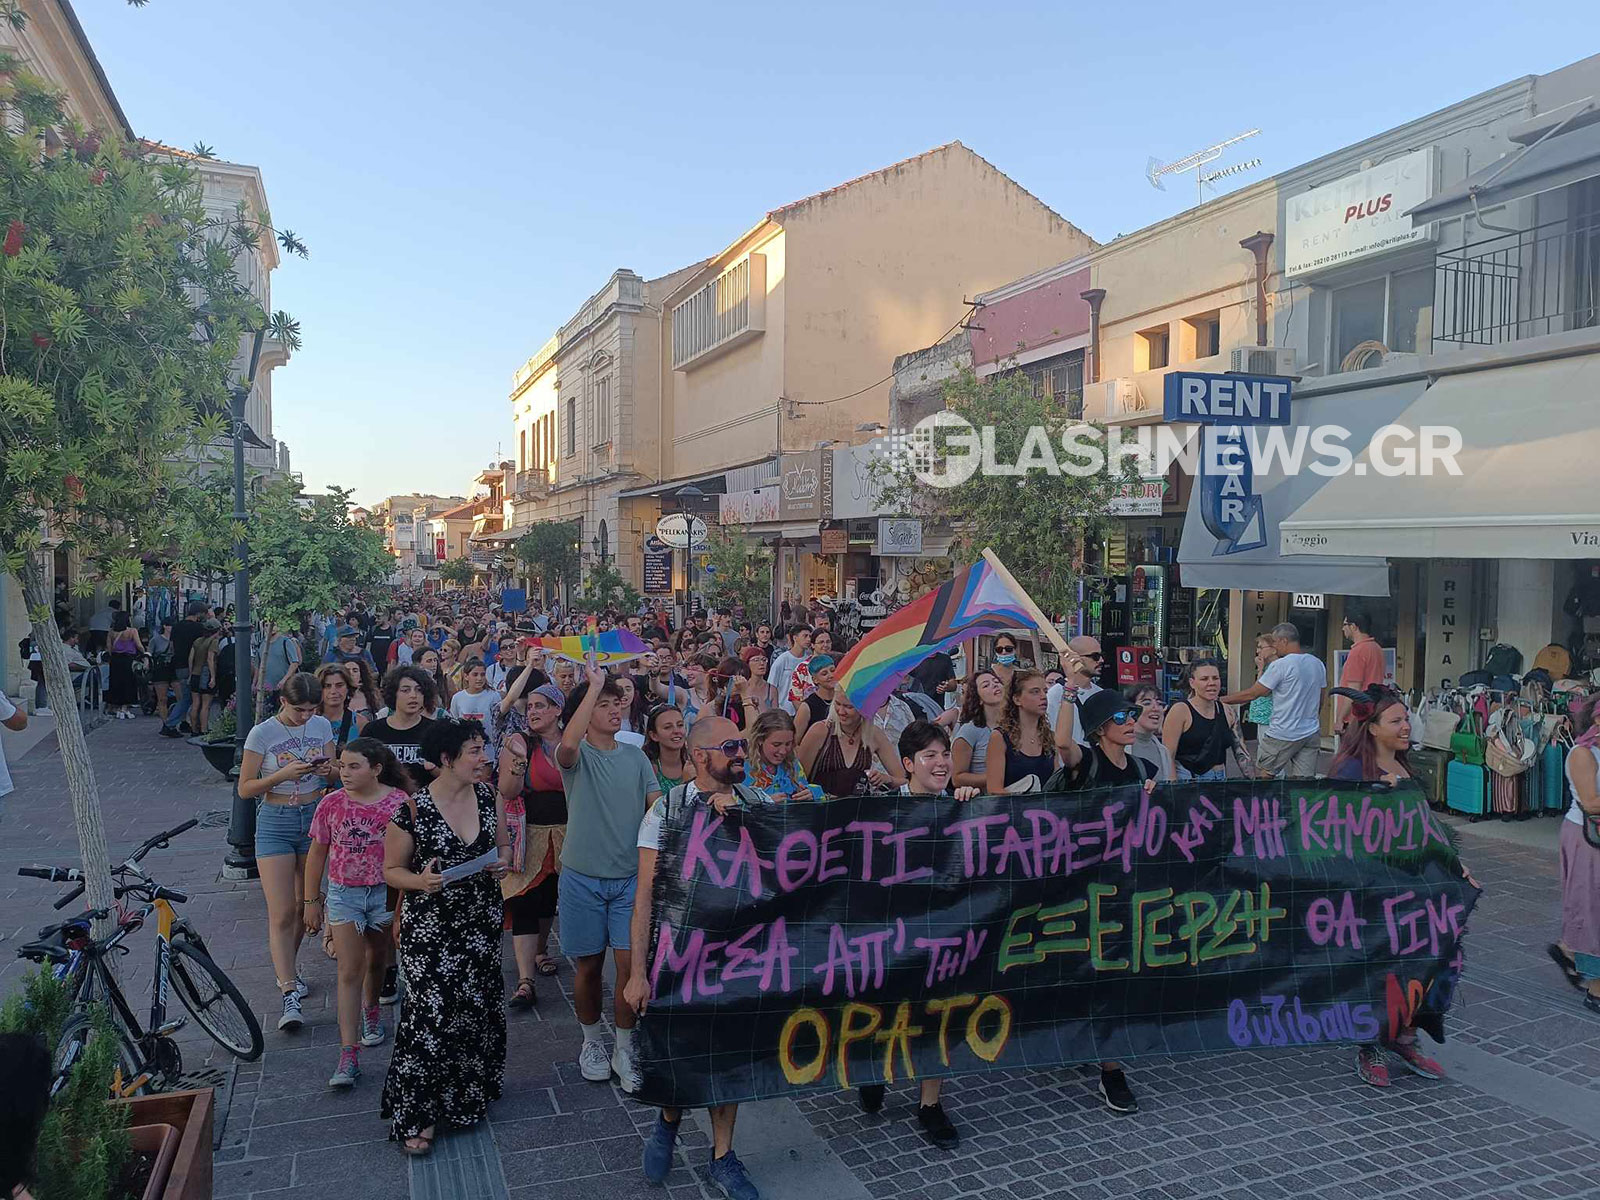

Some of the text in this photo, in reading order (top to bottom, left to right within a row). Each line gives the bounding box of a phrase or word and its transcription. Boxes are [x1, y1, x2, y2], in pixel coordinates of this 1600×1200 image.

[1344, 193, 1393, 225] PLUS
[1302, 227, 1342, 249] RENT
[1181, 377, 1288, 419] RENT
[1226, 425, 1241, 443] A
[822, 460, 833, 507] FALAFEL
[1220, 447, 1246, 523] CAR
[1570, 531, 1600, 548] Via
[1256, 590, 1265, 624] ENT
[1296, 594, 1320, 606] ATM
[1441, 580, 1456, 643] RENT
[1442, 654, 1452, 665] A
[342, 817, 357, 829] ME
[360, 817, 375, 826] ON
[680, 809, 934, 898] ΚΑΘΕΤΙ
[1232, 796, 1288, 860] ΜΗ
[650, 916, 800, 1003] ΜΕΣΑ
[1306, 890, 1368, 950] ΘΑ
[778, 994, 1012, 1089] ΟΡΑΤΟ
